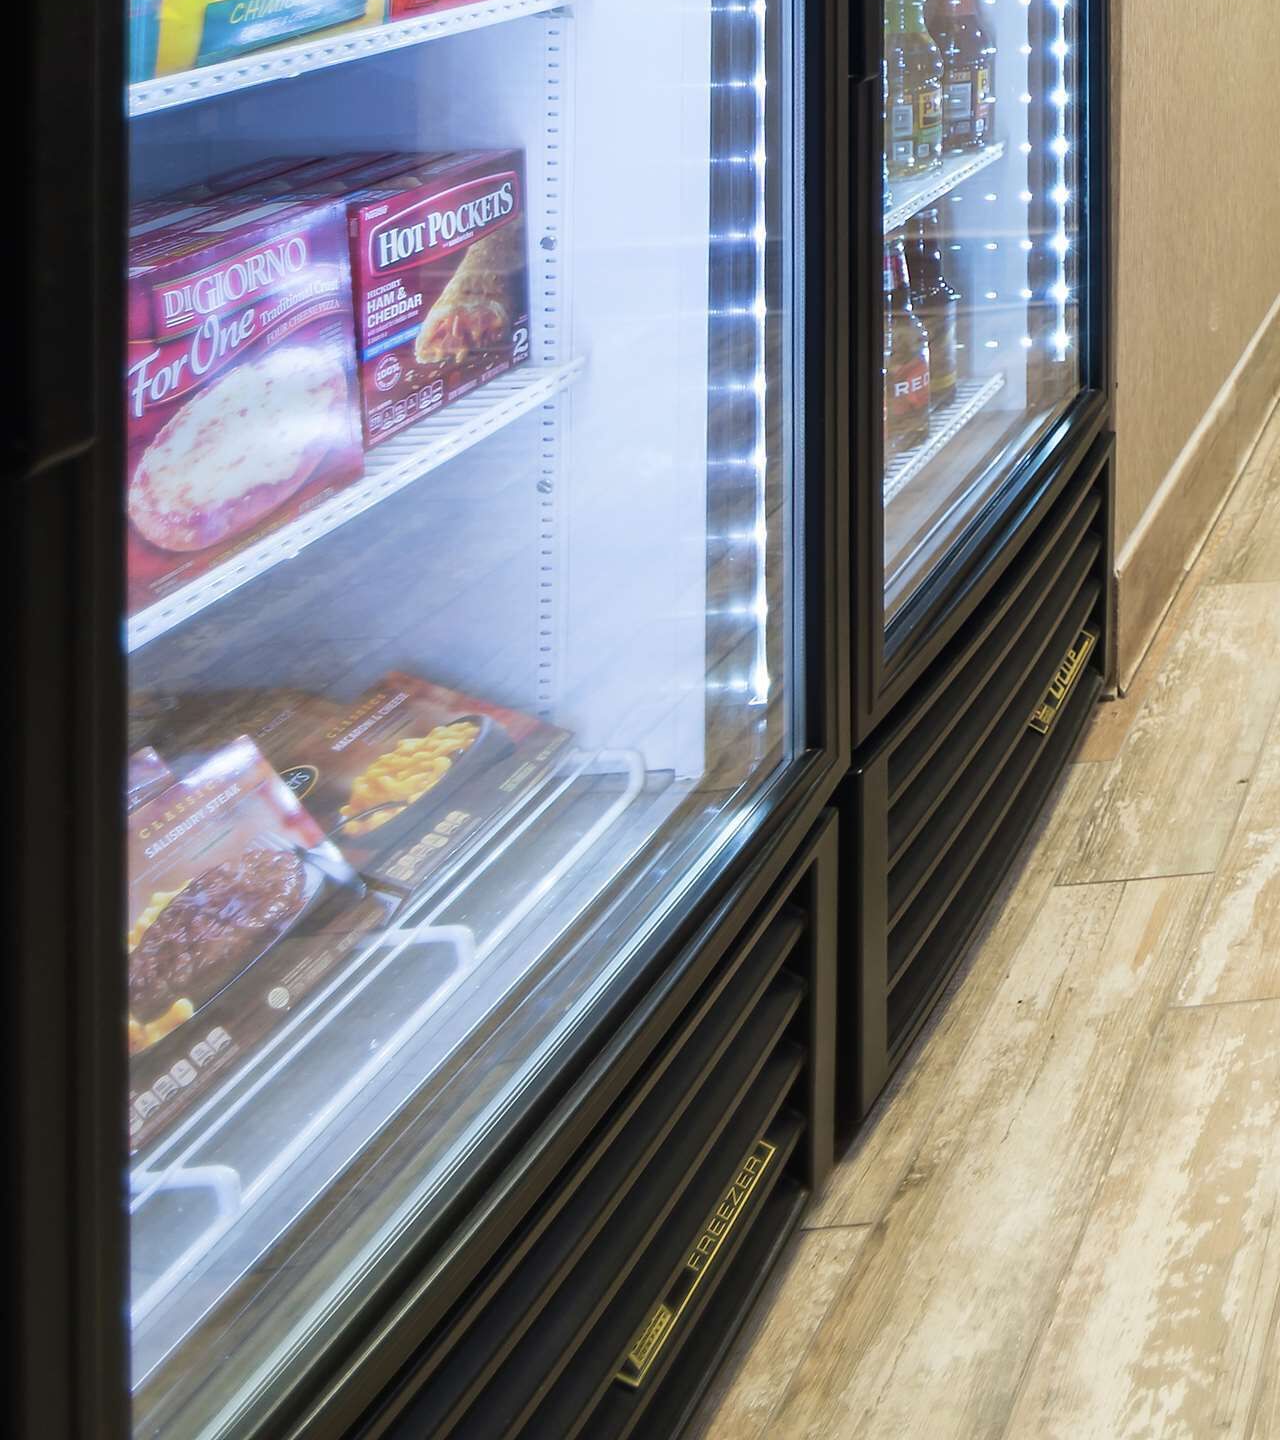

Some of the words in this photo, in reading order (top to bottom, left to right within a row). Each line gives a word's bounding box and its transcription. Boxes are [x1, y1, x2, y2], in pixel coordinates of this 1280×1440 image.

[379, 223, 425, 267] HOT
[428, 182, 514, 247] POCKETS
[367, 292, 394, 314] HAM
[397, 287, 407, 301] &
[367, 293, 423, 328] CHEDDAR
[130, 350, 187, 417] For
[192, 304, 255, 373] One
[513, 328, 528, 356] 2
[144, 811, 204, 859] SALISBURY
[205, 784, 241, 813] STEAK
[687, 1154, 764, 1273] FREEZER
